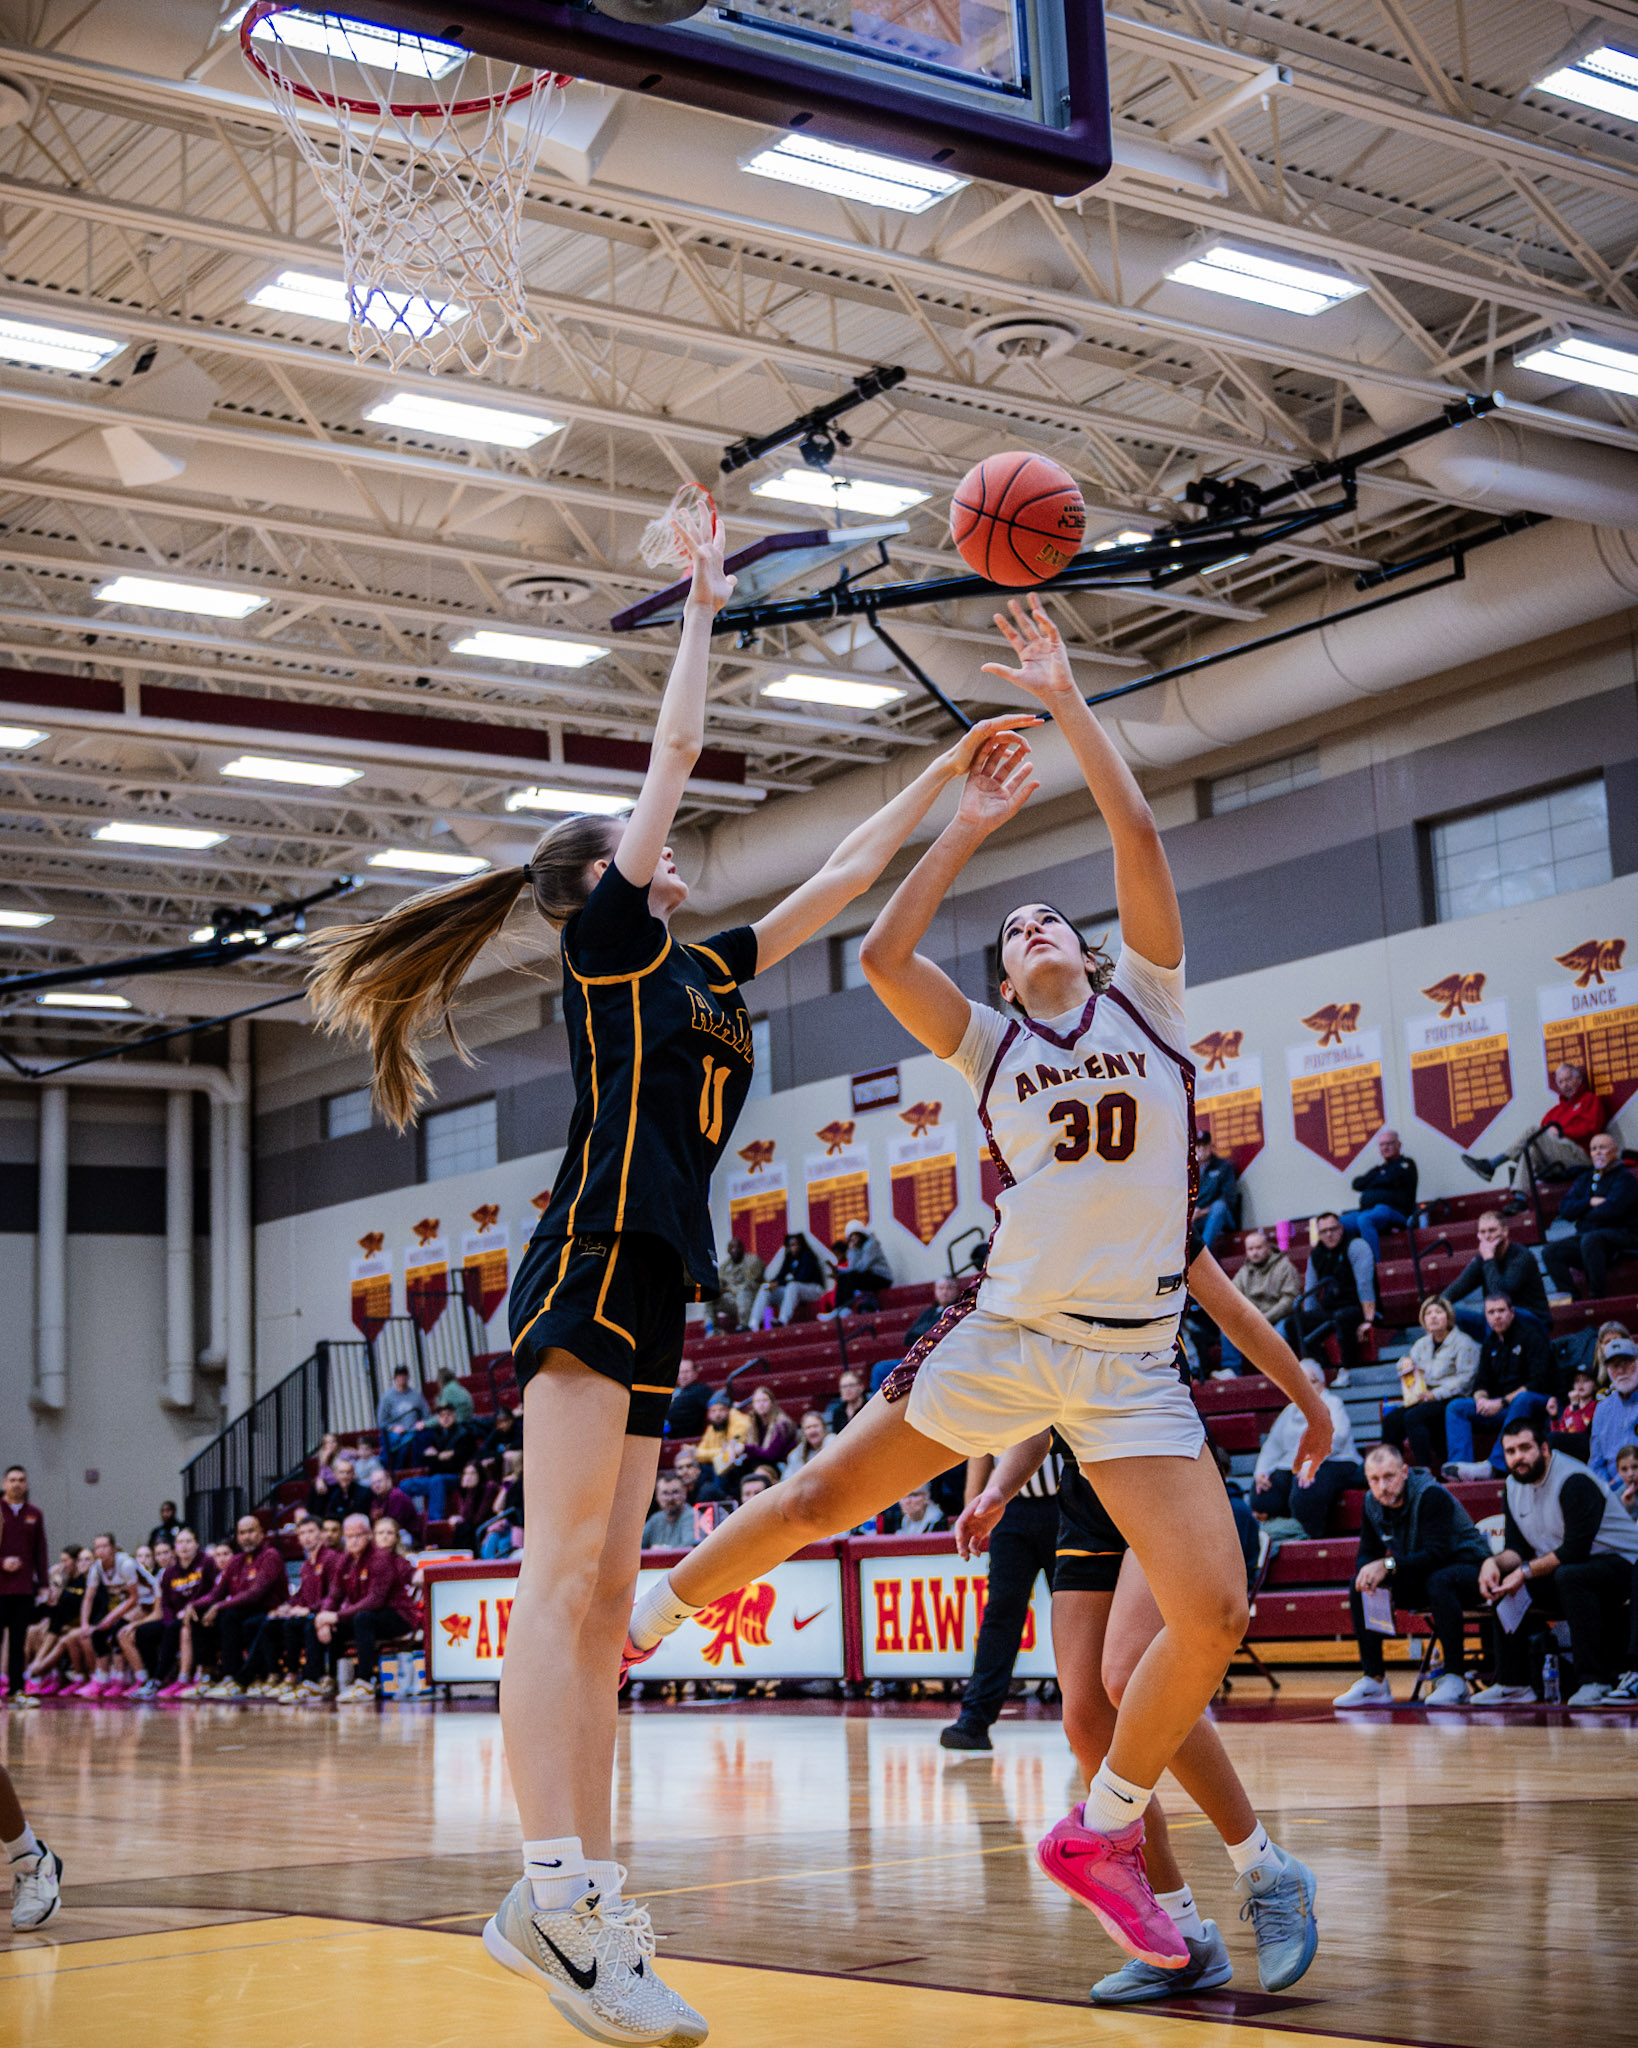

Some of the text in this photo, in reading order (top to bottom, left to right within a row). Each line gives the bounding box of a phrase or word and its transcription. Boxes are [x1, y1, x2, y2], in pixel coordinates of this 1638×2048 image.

[1572, 987, 1617, 1012] DANCE
[1425, 1017, 1489, 1045] FOOTBALL
[1304, 1046, 1364, 1072] FOOTBALL
[1015, 1051, 1147, 1104] ANKENY
[1048, 1091, 1138, 1163] 30
